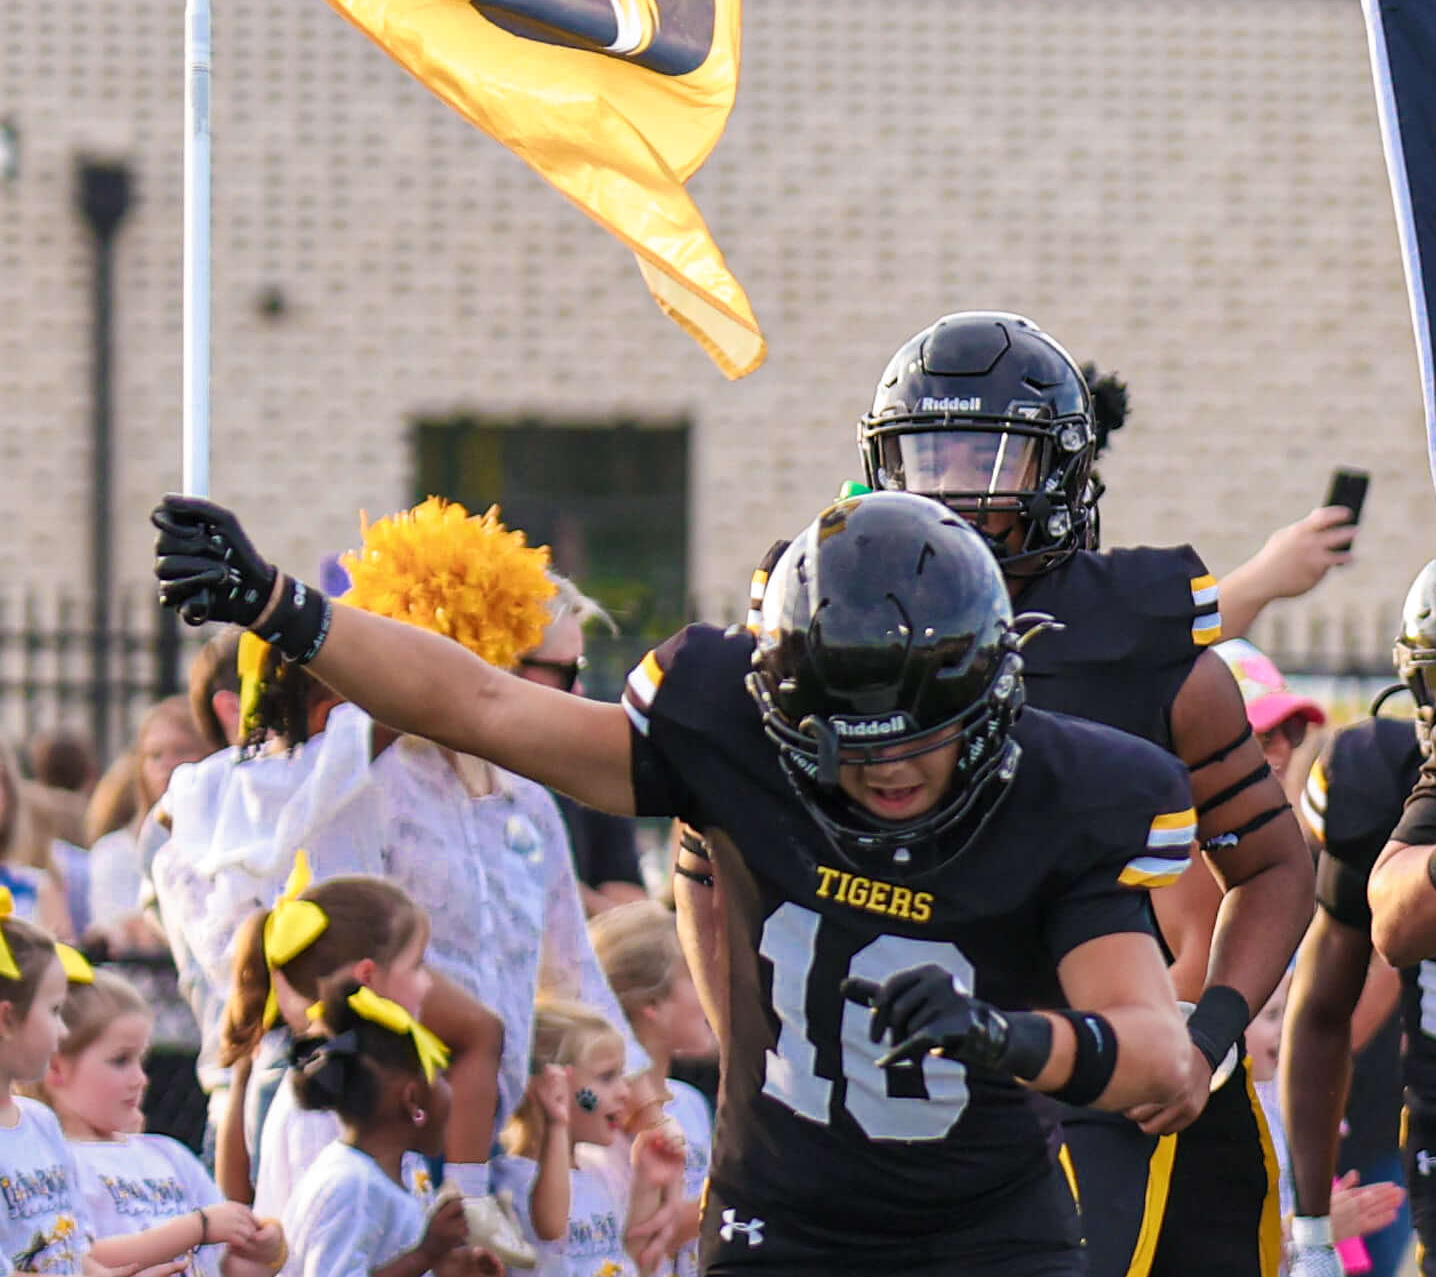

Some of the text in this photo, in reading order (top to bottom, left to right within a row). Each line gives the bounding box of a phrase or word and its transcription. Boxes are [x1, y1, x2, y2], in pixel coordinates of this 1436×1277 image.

[922, 397, 982, 412] Riddell
[831, 714, 906, 737] Riddell
[815, 865, 935, 923] TIGERS
